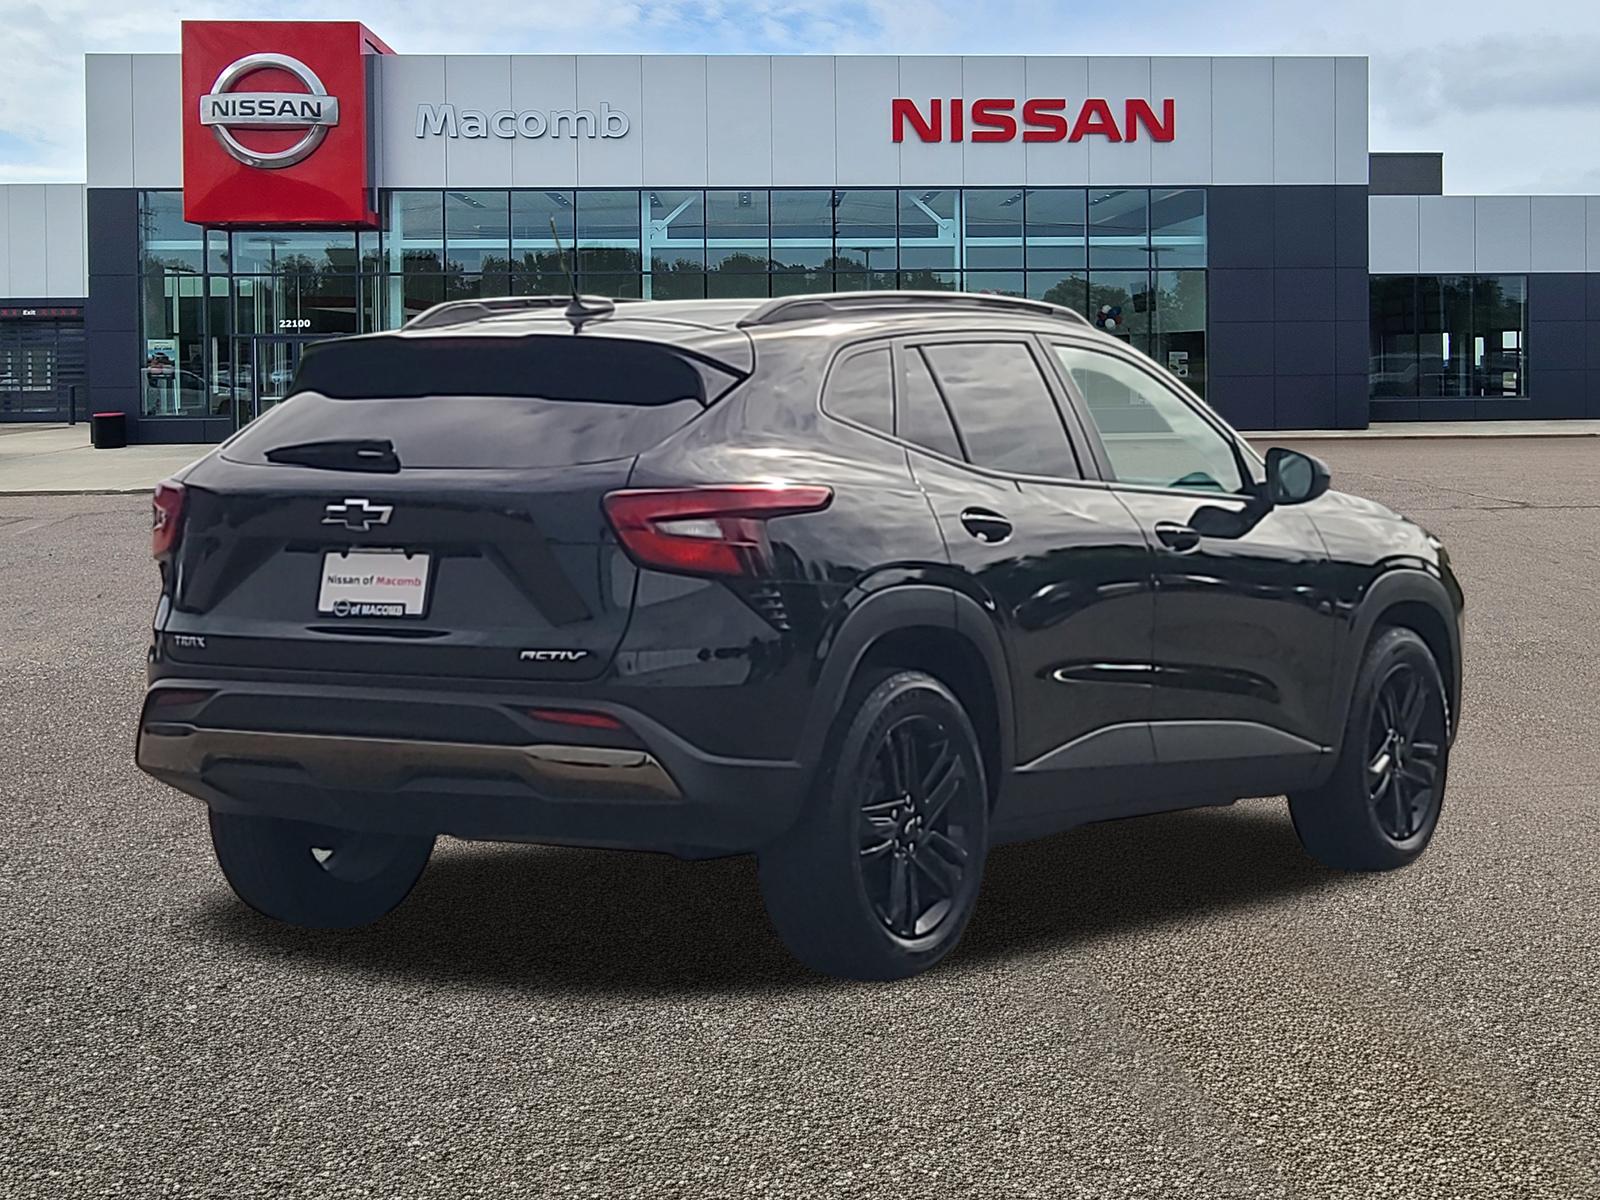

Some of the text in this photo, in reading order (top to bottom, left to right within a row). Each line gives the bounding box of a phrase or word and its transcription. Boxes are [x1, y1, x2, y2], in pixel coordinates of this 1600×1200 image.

[211, 100, 322, 117] NISSAN
[415, 102, 630, 139] Macomb
[892, 98, 1176, 143] NISSAN
[279, 319, 311, 328] 22100
[327, 575, 422, 587] Nissan of Macomb
[520, 650, 588, 661] ACTIV
